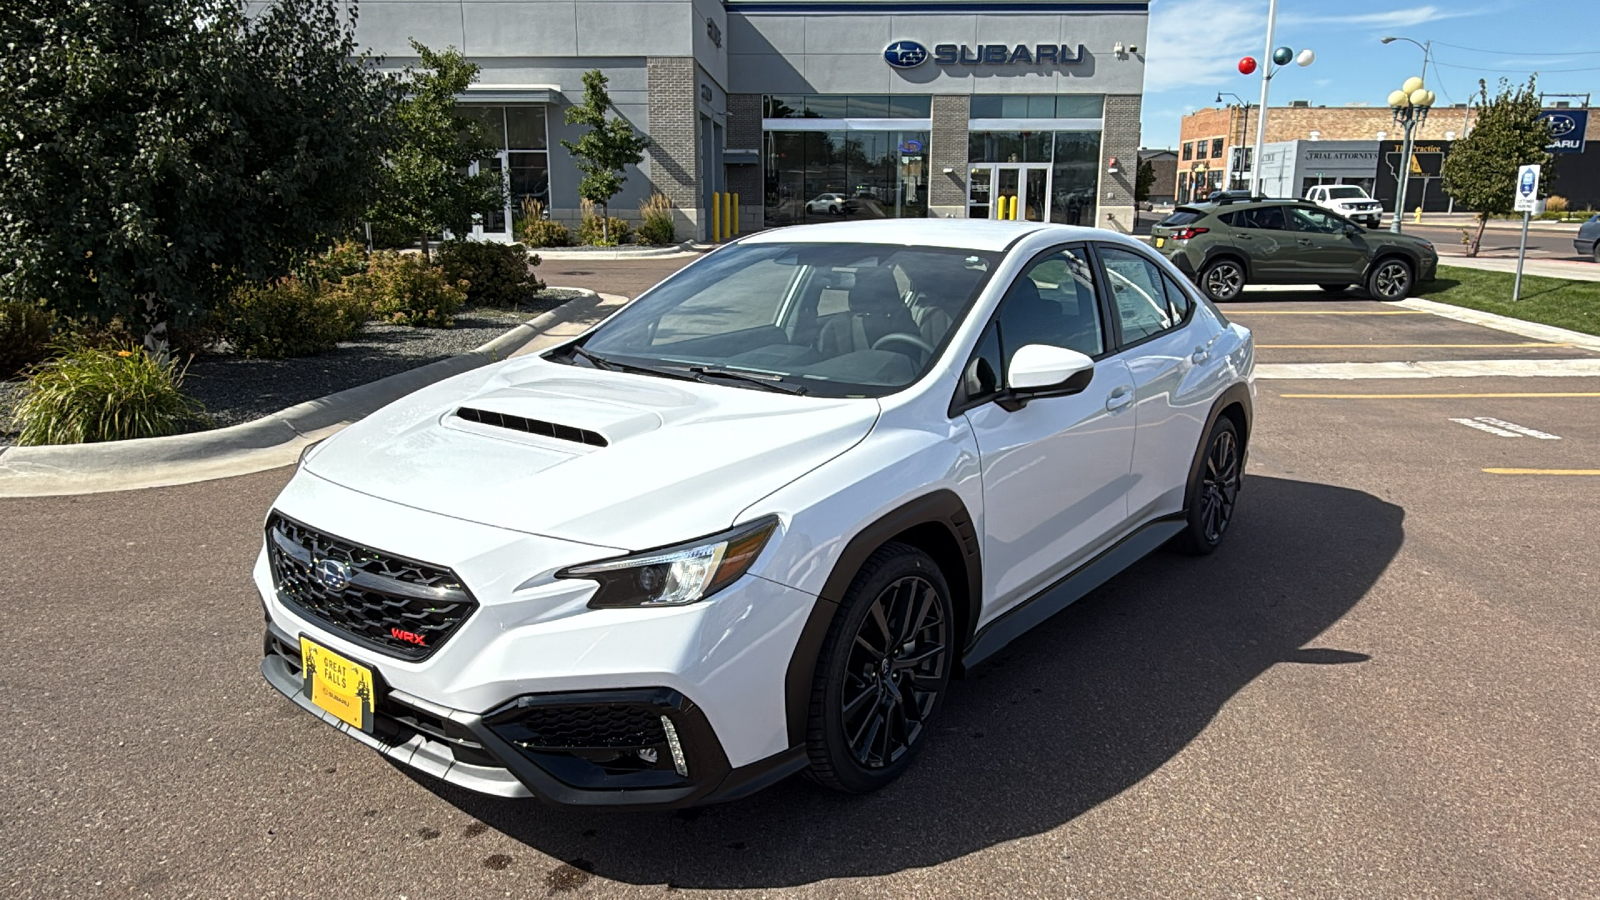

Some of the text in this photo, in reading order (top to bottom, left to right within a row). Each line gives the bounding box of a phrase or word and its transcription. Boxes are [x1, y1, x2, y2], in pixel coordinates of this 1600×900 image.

[935, 44, 1084, 65] SUBARU
[1545, 140, 1580, 148] ARU
[391, 628, 425, 644] WRX
[323, 657, 347, 676] GREAT
[324, 669, 347, 689] FALLS
[328, 691, 350, 707] SUBARU
